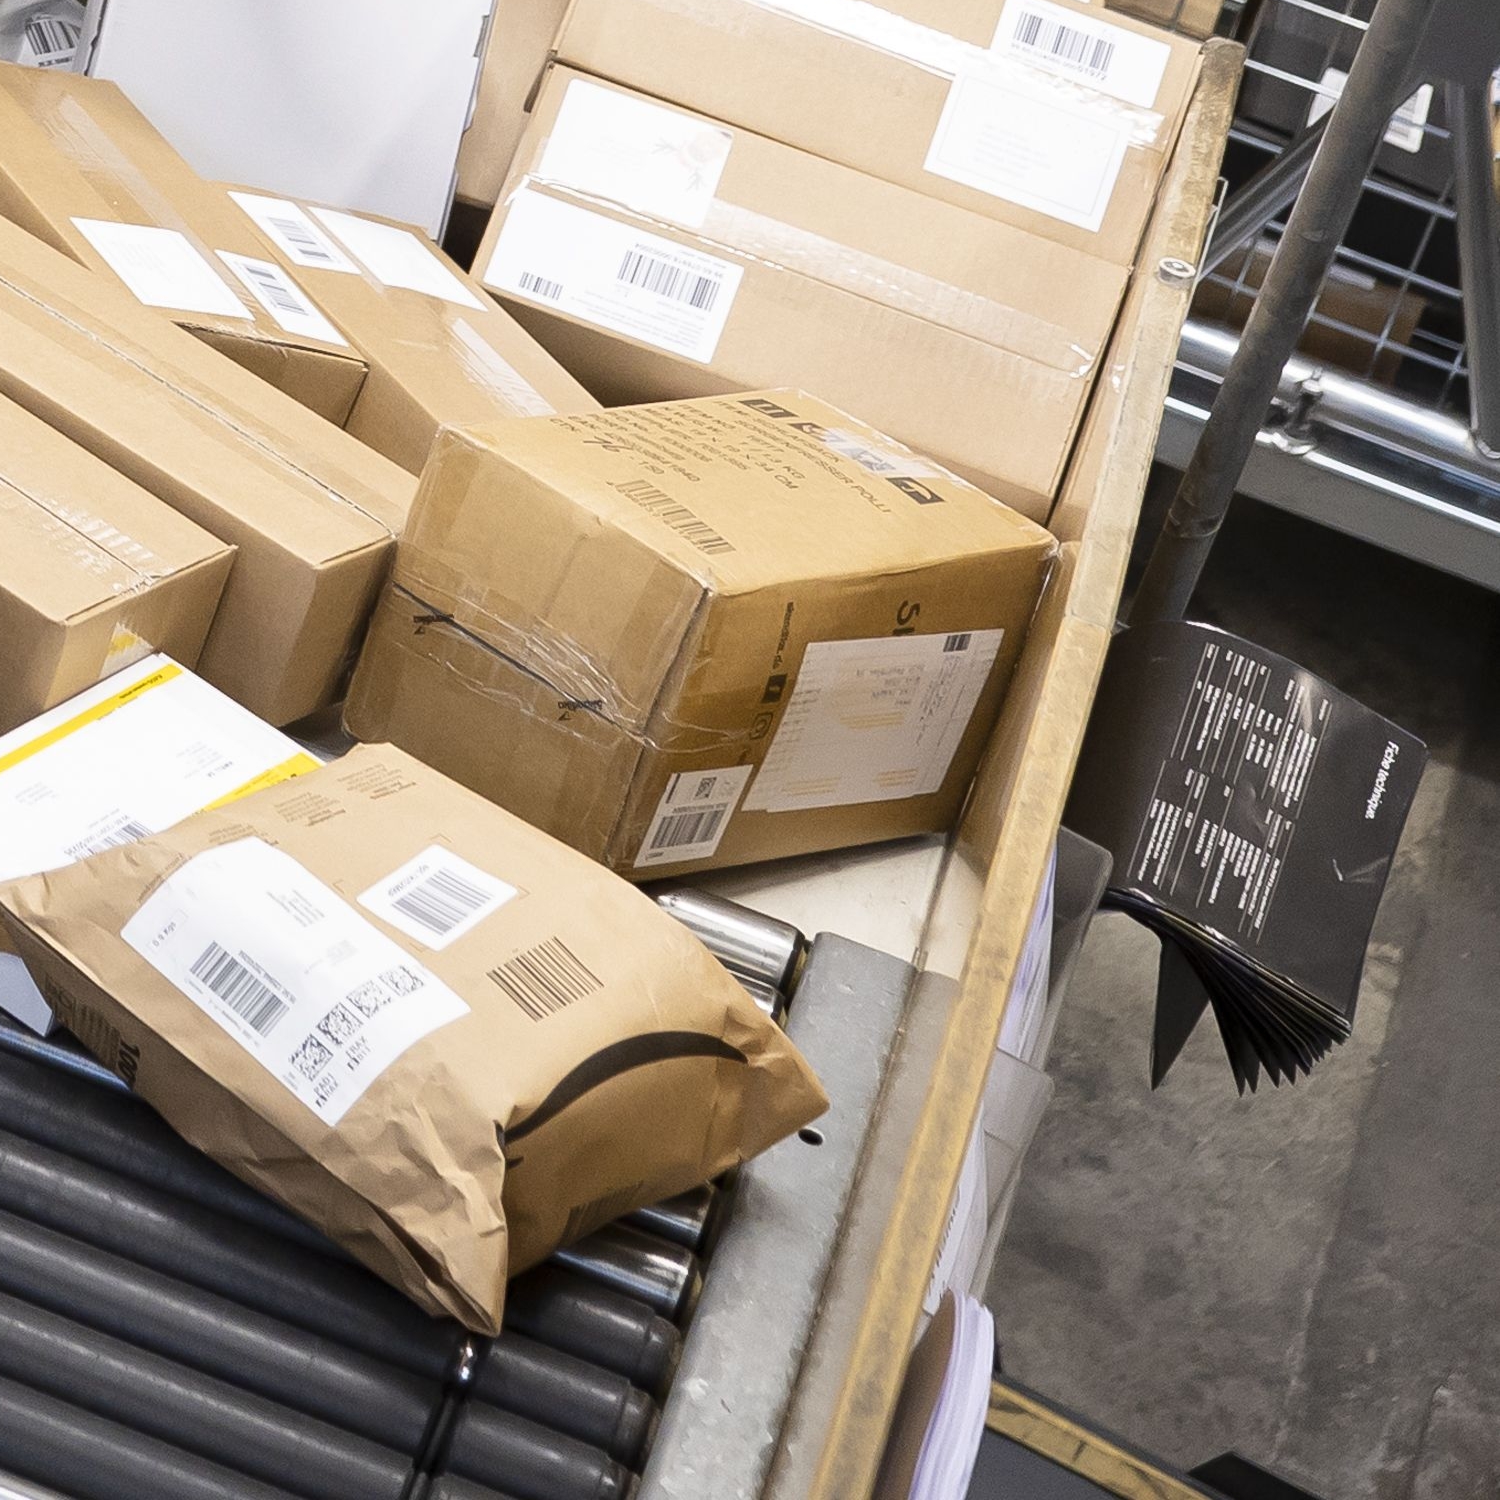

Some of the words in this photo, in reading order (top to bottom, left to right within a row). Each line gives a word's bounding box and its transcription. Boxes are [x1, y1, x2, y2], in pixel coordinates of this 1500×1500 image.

[733, 419, 854, 485] SORGENFRESSER
[850, 484, 893, 514] POLLI
[774, 473, 800, 491] CM
[1382, 740, 1400, 775] Fiche
[1364, 775, 1392, 820] technique.
